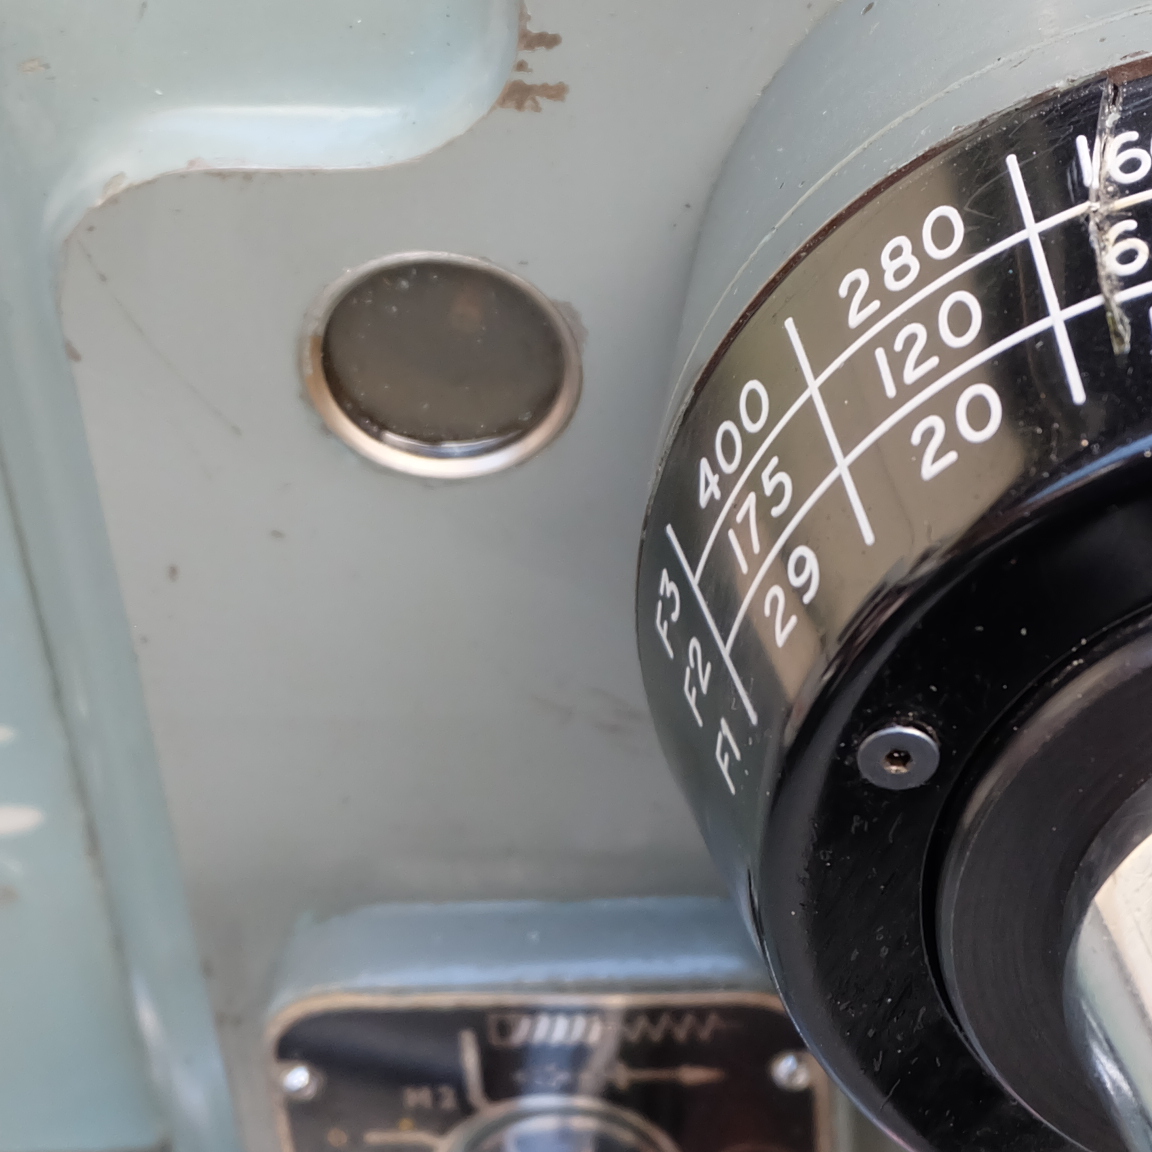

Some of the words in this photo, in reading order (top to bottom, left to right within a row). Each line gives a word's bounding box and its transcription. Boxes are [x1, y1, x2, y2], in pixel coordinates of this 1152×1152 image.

[838, 205, 965, 330] 280
[875, 290, 983, 398] 120
[698, 379, 769, 509] 400
[911, 382, 1003, 482] 20
[727, 455, 794, 575] 175
[656, 567, 680, 660] F3
[763, 545, 820, 648] 29
[684, 636, 712, 728] F2
[715, 716, 742, 795] F1
